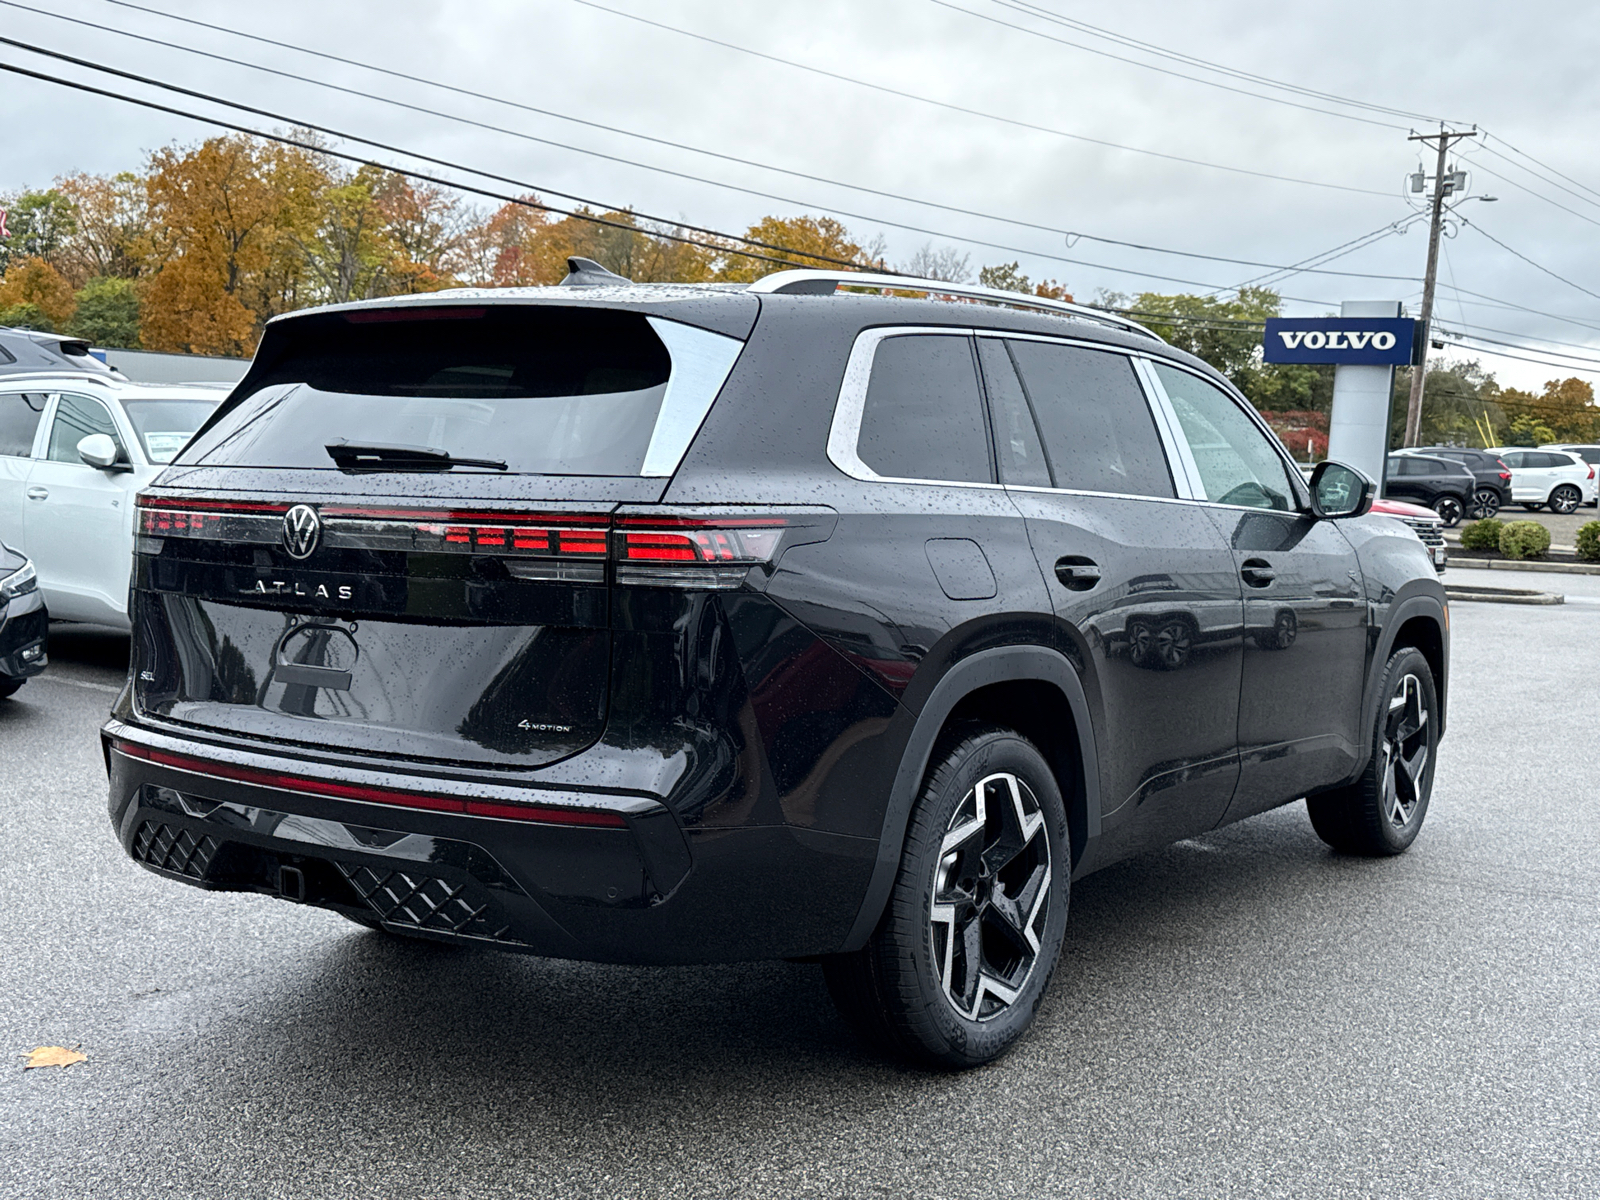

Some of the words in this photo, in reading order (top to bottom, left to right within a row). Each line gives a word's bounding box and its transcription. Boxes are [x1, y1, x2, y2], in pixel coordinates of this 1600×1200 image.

[1277, 331, 1397, 350] VOLVO
[254, 579, 353, 600] ATLAS
[140, 670, 155, 681] SEL
[517, 719, 571, 732] 4MOTION
